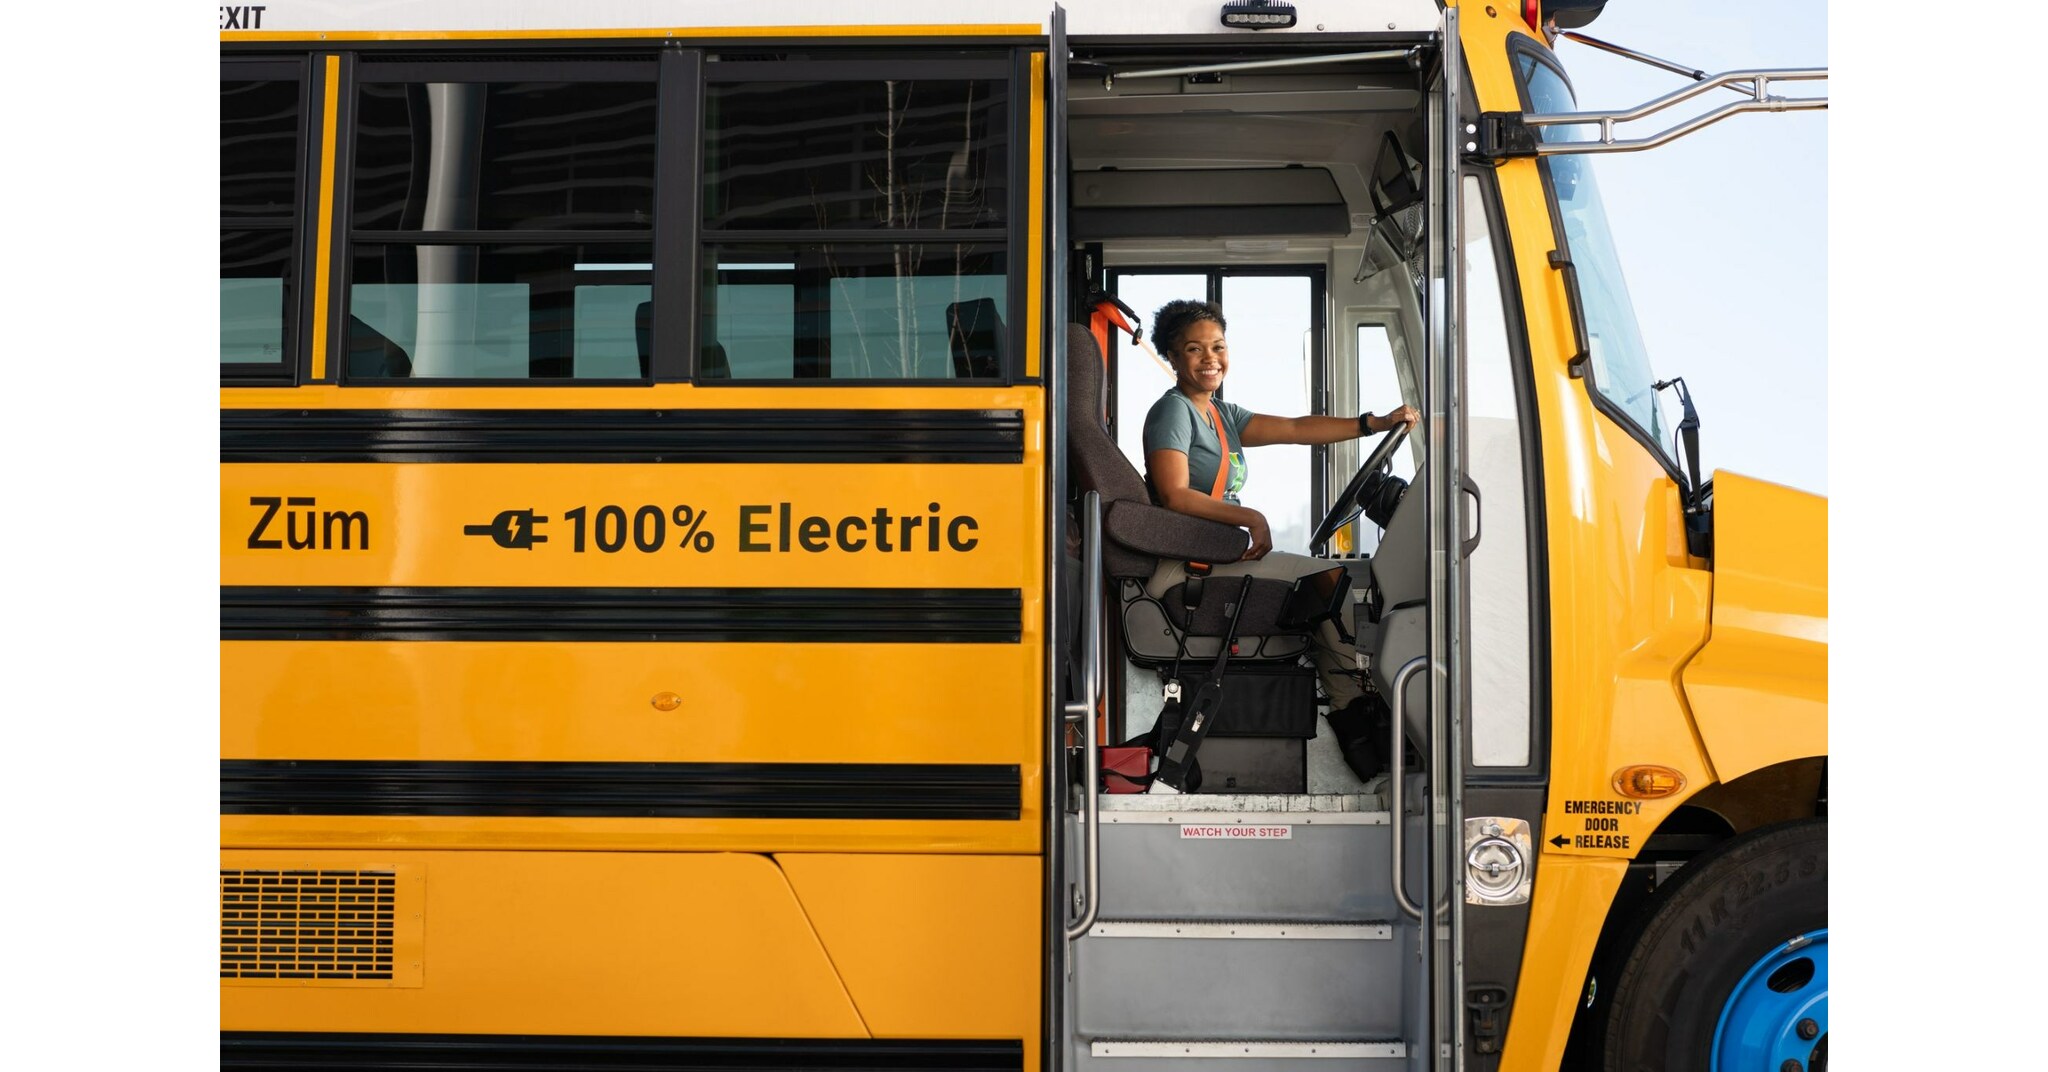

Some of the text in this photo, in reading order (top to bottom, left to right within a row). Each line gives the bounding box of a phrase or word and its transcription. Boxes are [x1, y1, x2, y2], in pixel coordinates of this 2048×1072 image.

[247, 496, 370, 551] Zūm
[563, 502, 980, 554] 100% Electric
[1565, 800, 1641, 815] EMERGENCY
[1183, 827, 1288, 837] WATCH YOUR STEP
[1585, 817, 1619, 832] DOOR
[1575, 834, 1630, 849] RELEASE
